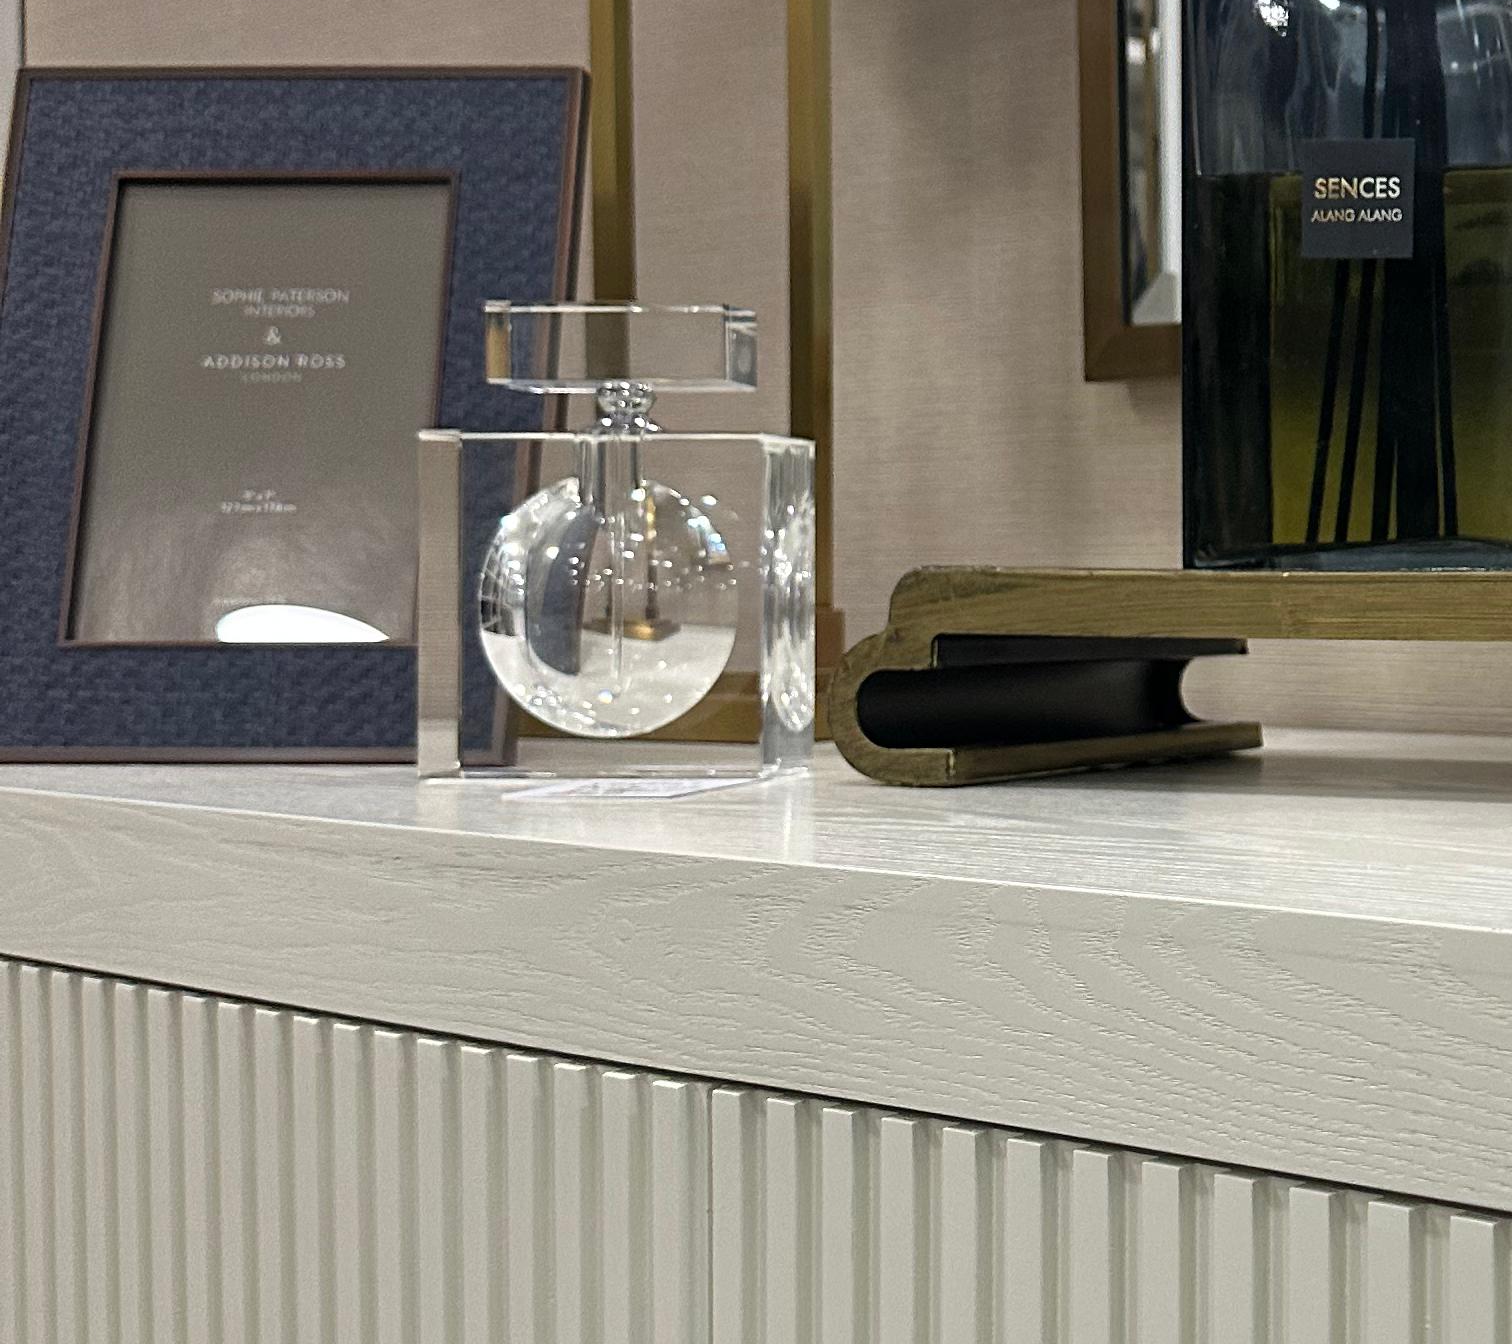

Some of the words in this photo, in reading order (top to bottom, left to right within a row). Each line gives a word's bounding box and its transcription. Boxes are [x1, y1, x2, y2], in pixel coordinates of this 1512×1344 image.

[1314, 176, 1401, 199] SENCES
[1311, 208, 1356, 223] ALANG
[1358, 208, 1403, 223] ALANG
[271, 287, 350, 304] PATERSON
[265, 325, 281, 346] &
[202, 354, 290, 369] ADDISON
[297, 354, 346, 369] ROSS
